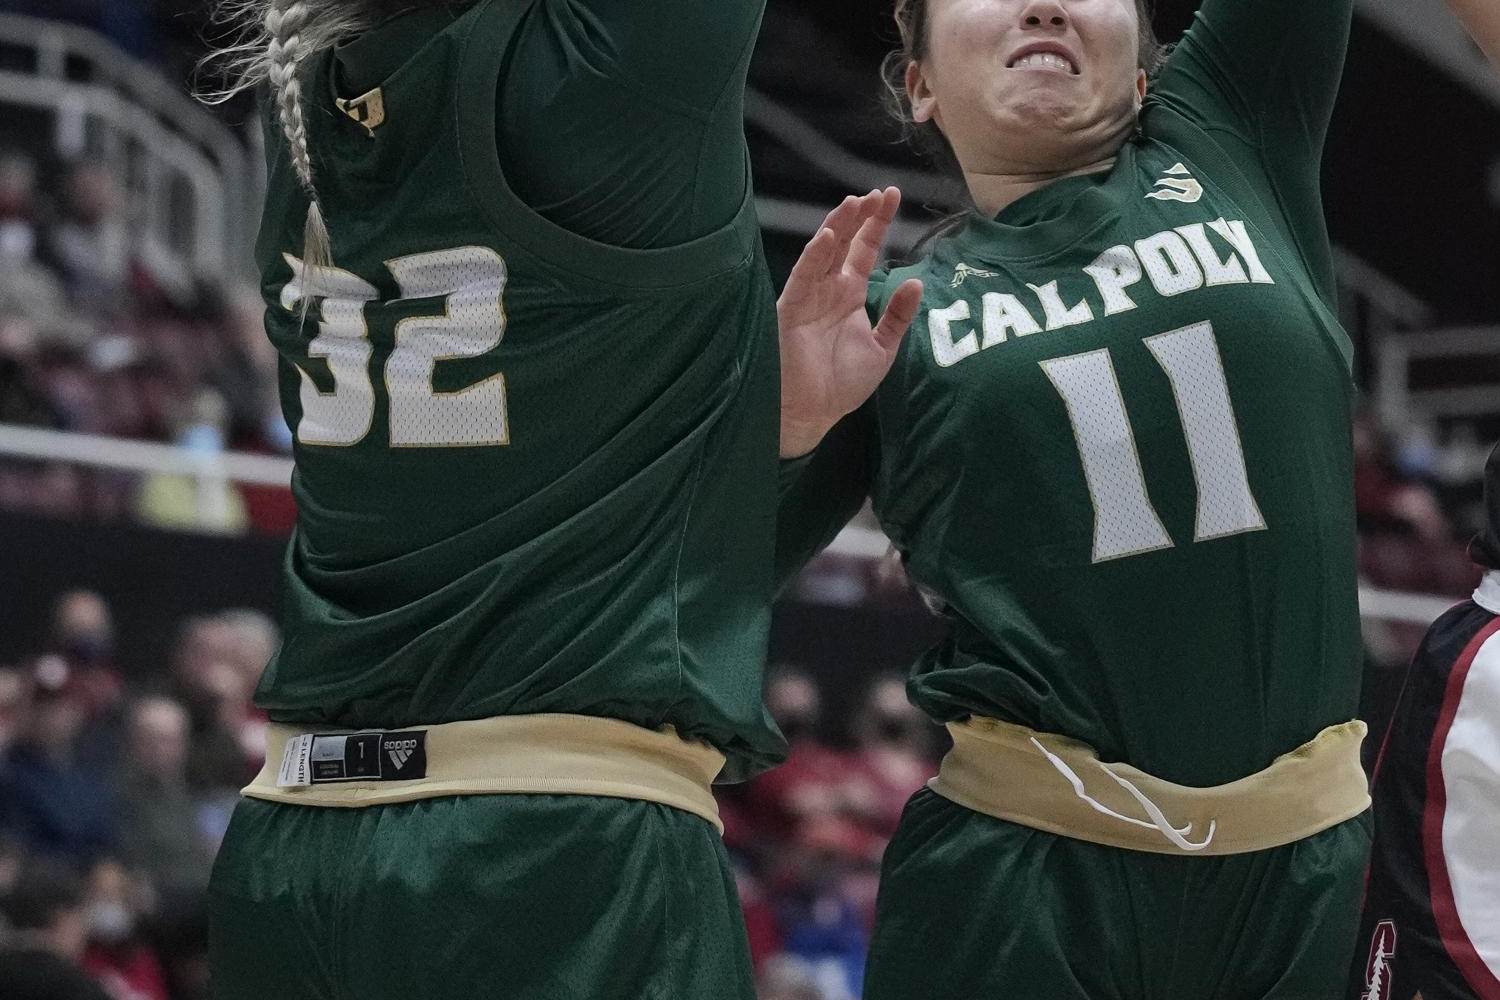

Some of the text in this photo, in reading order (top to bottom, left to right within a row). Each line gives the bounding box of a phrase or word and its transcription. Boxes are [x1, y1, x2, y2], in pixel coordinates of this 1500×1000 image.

[279, 245, 511, 449] 32
[927, 217, 1276, 368] CAL POLY
[1037, 319, 1269, 564] 11
[384, 739, 417, 751] adidas
